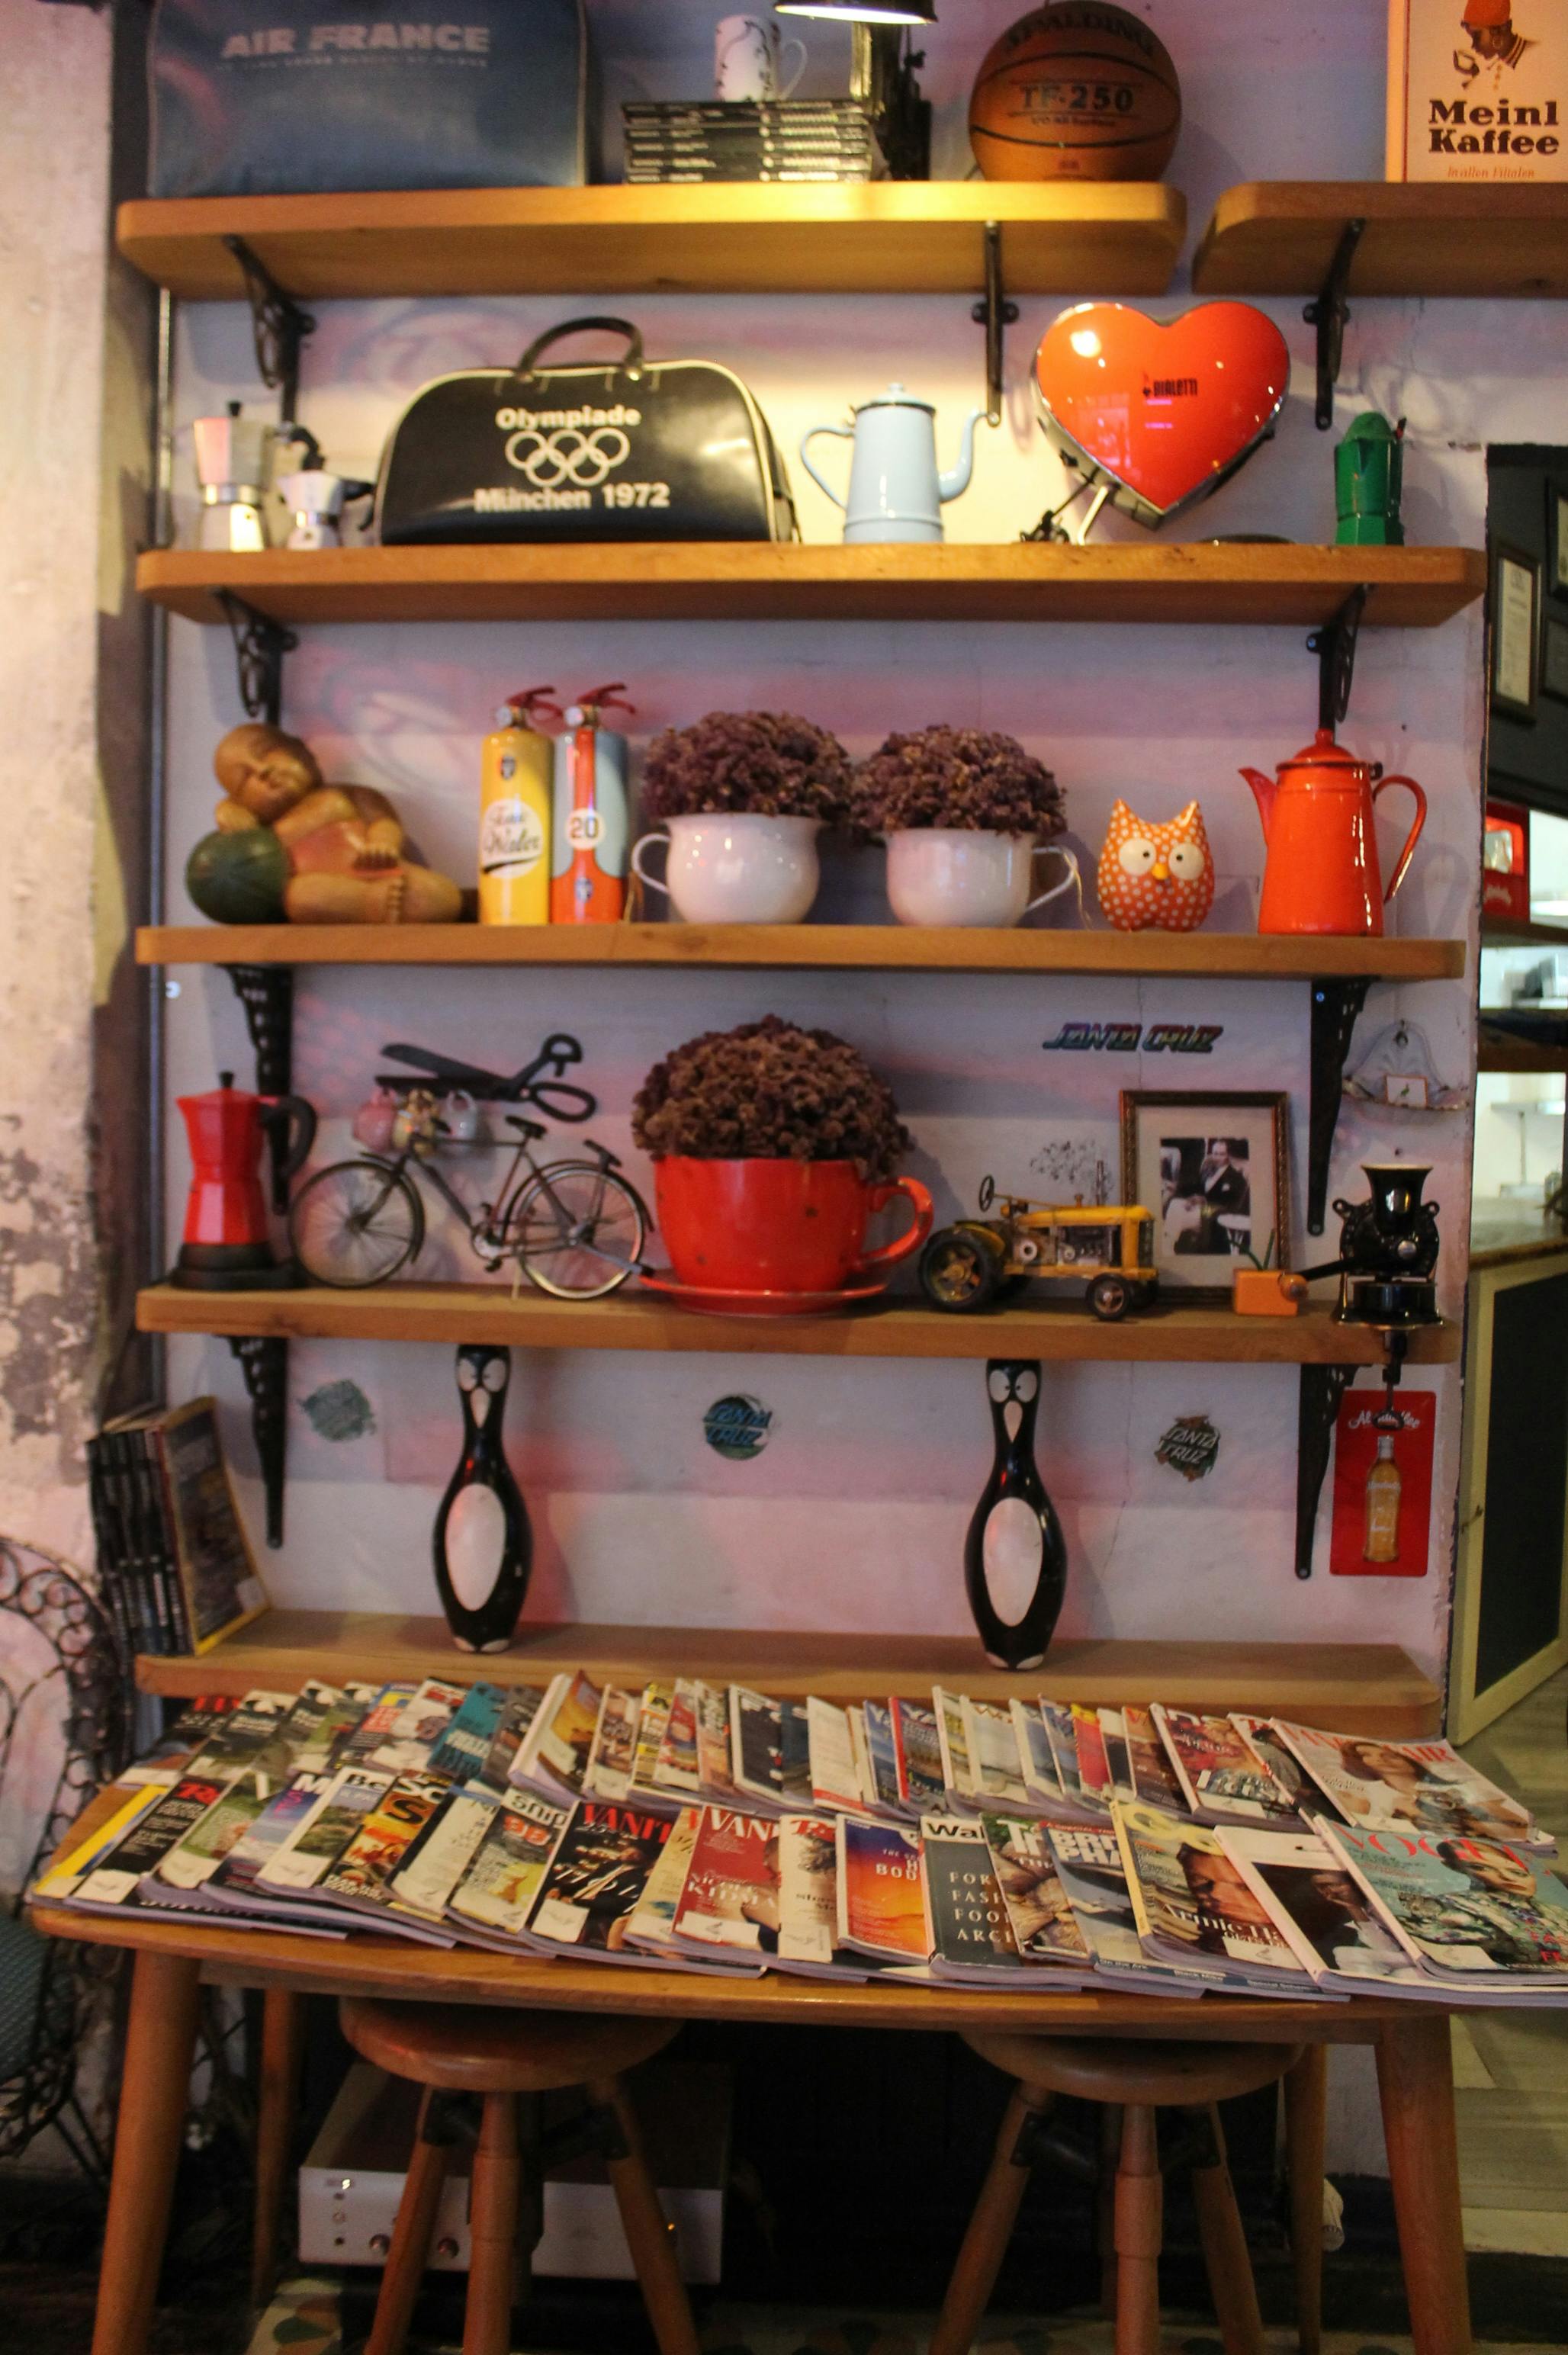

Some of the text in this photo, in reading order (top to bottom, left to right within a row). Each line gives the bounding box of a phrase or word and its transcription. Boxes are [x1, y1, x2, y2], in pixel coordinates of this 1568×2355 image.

[221, 23, 490, 59] AIR FRANCE
[1428, 98, 1559, 127] Meinl
[1428, 128, 1560, 156] Kaffee
[496, 405, 641, 431] Olympiade
[474, 482, 670, 513] München 1972
[570, 816, 599, 839] 20
[1142, 1024, 1224, 1053] CRUZ
[1167, 1426, 1219, 1450] SANTA
